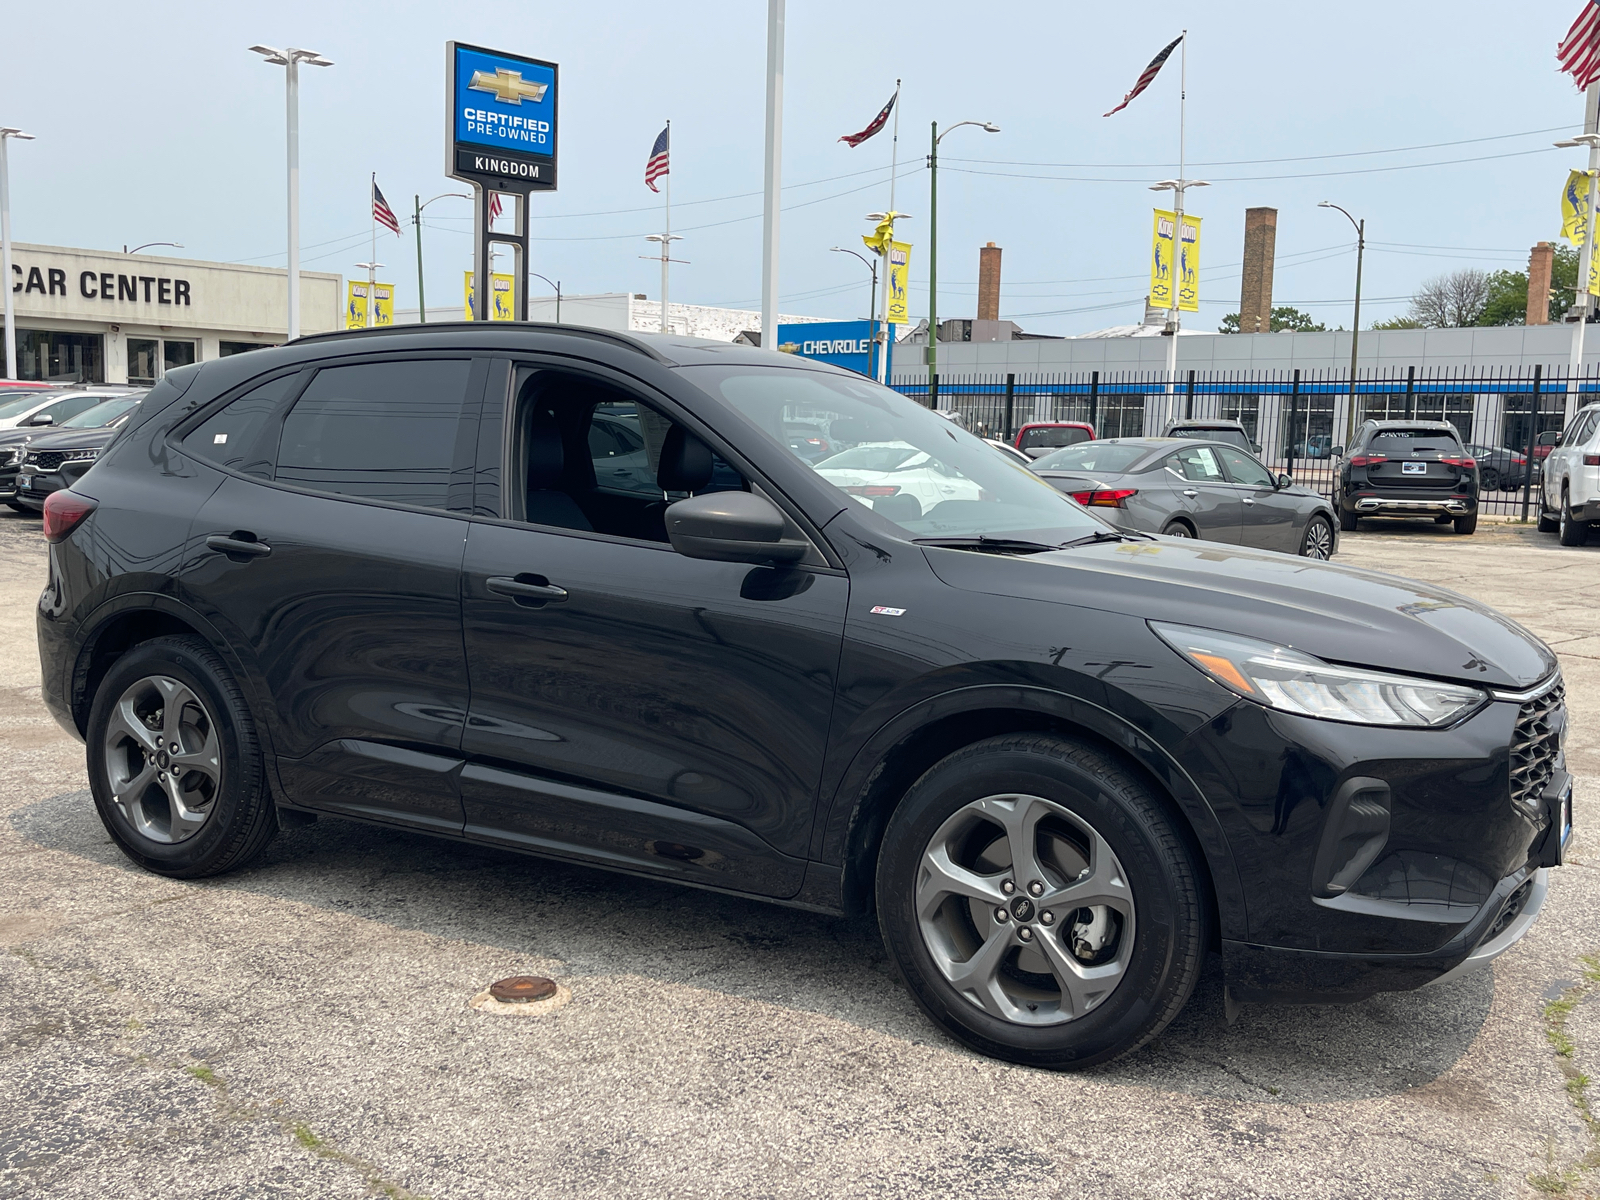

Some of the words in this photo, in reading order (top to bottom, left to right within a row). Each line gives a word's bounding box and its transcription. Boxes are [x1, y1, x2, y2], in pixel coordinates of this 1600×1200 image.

[464, 107, 549, 133] CERTIFIED
[467, 121, 546, 144] PRE-OWNED
[475, 156, 539, 178] KINGDOM
[1157, 216, 1174, 238] King
[1181, 222, 1196, 240] dom
[12, 264, 67, 296] CAR
[80, 271, 191, 306] CENTER
